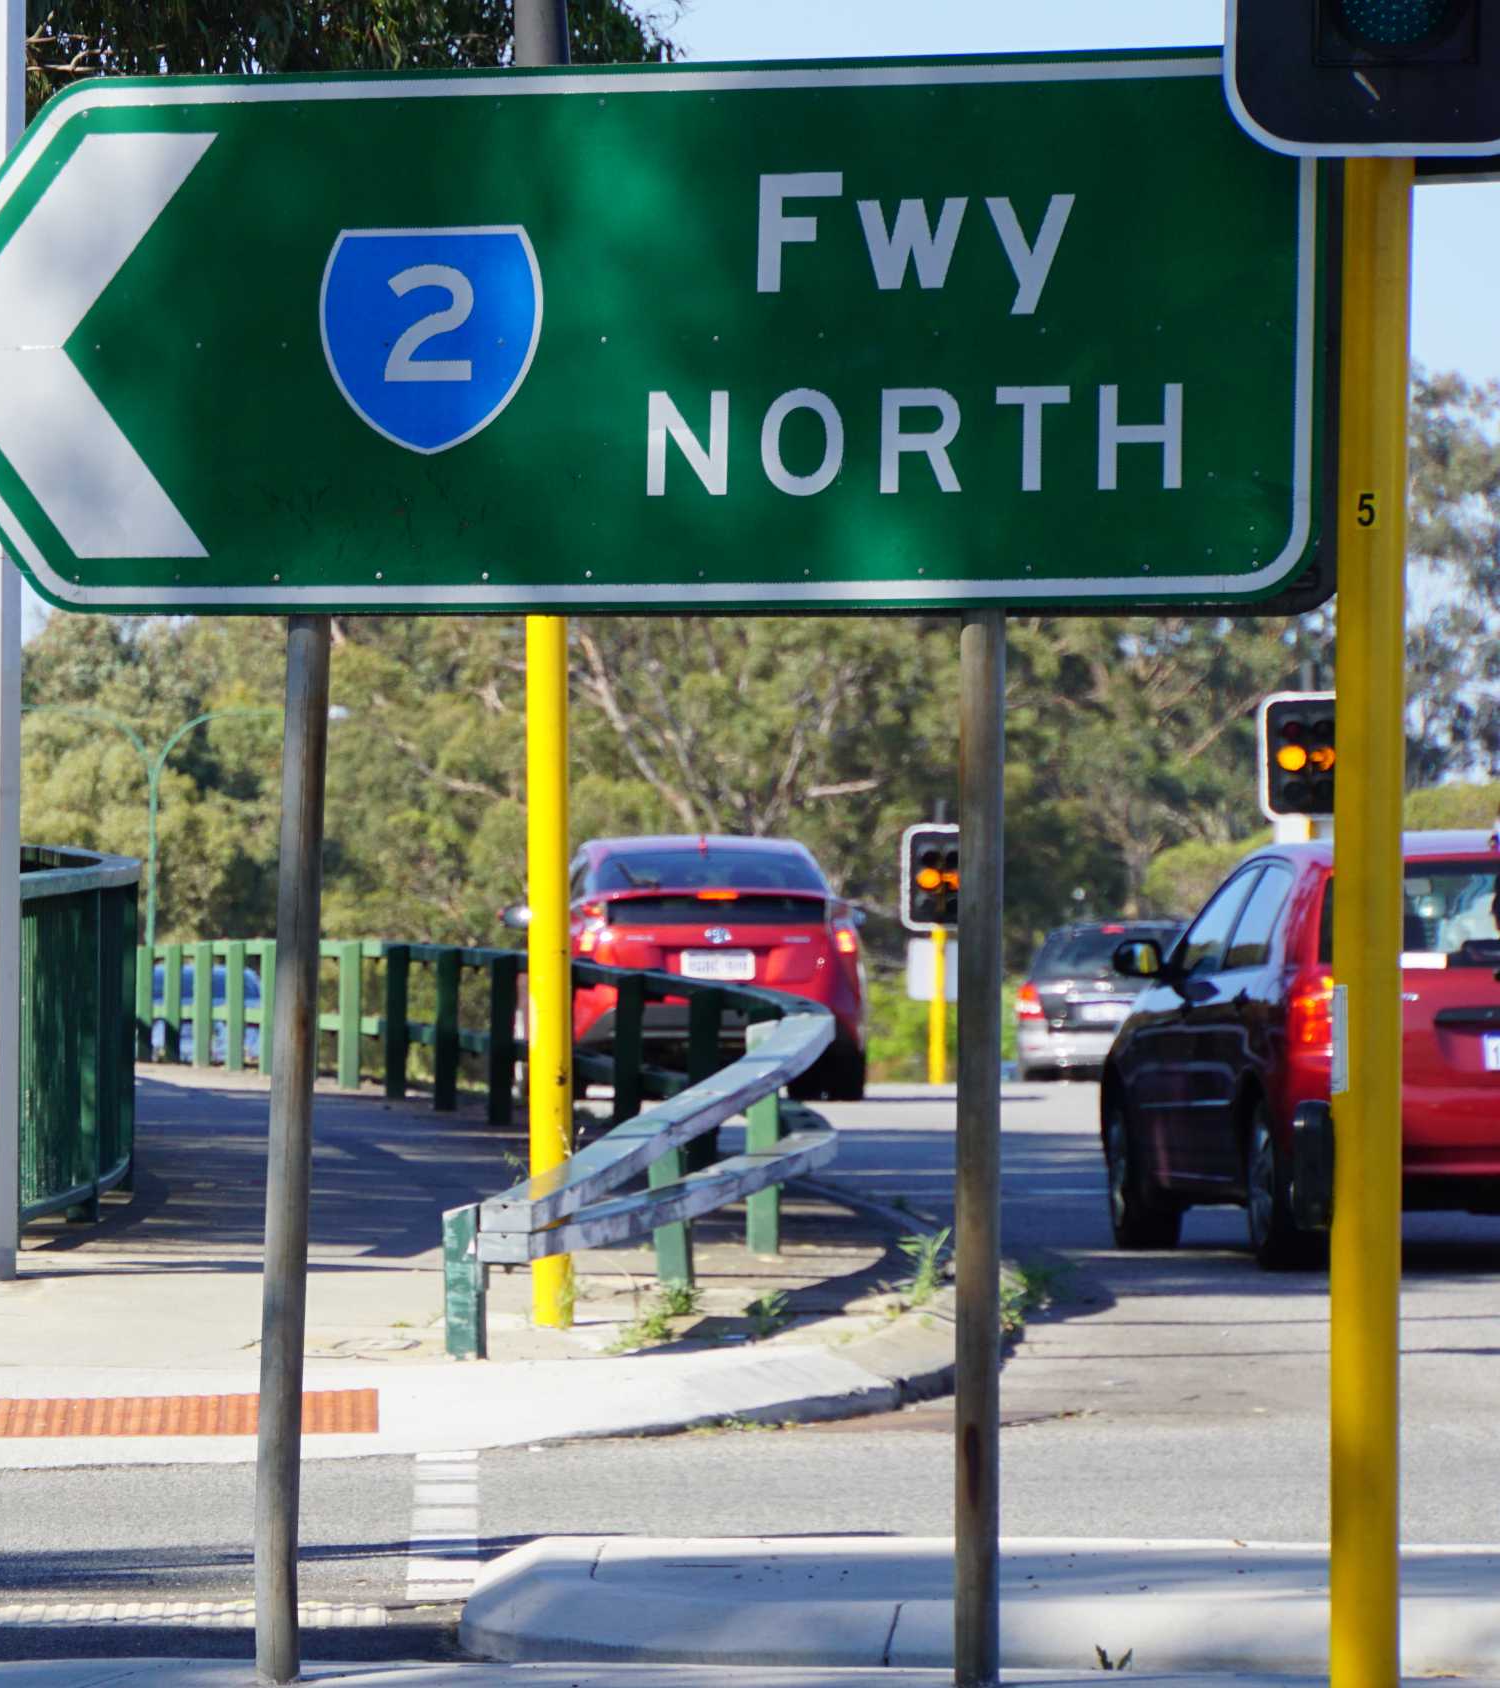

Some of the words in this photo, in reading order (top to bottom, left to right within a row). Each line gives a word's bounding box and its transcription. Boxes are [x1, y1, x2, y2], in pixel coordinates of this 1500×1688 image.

[757, 173, 1075, 314] Fwy
[386, 265, 474, 381] 2
[646, 384, 1182, 496] NORTH
[1357, 493, 1375, 527] 5
